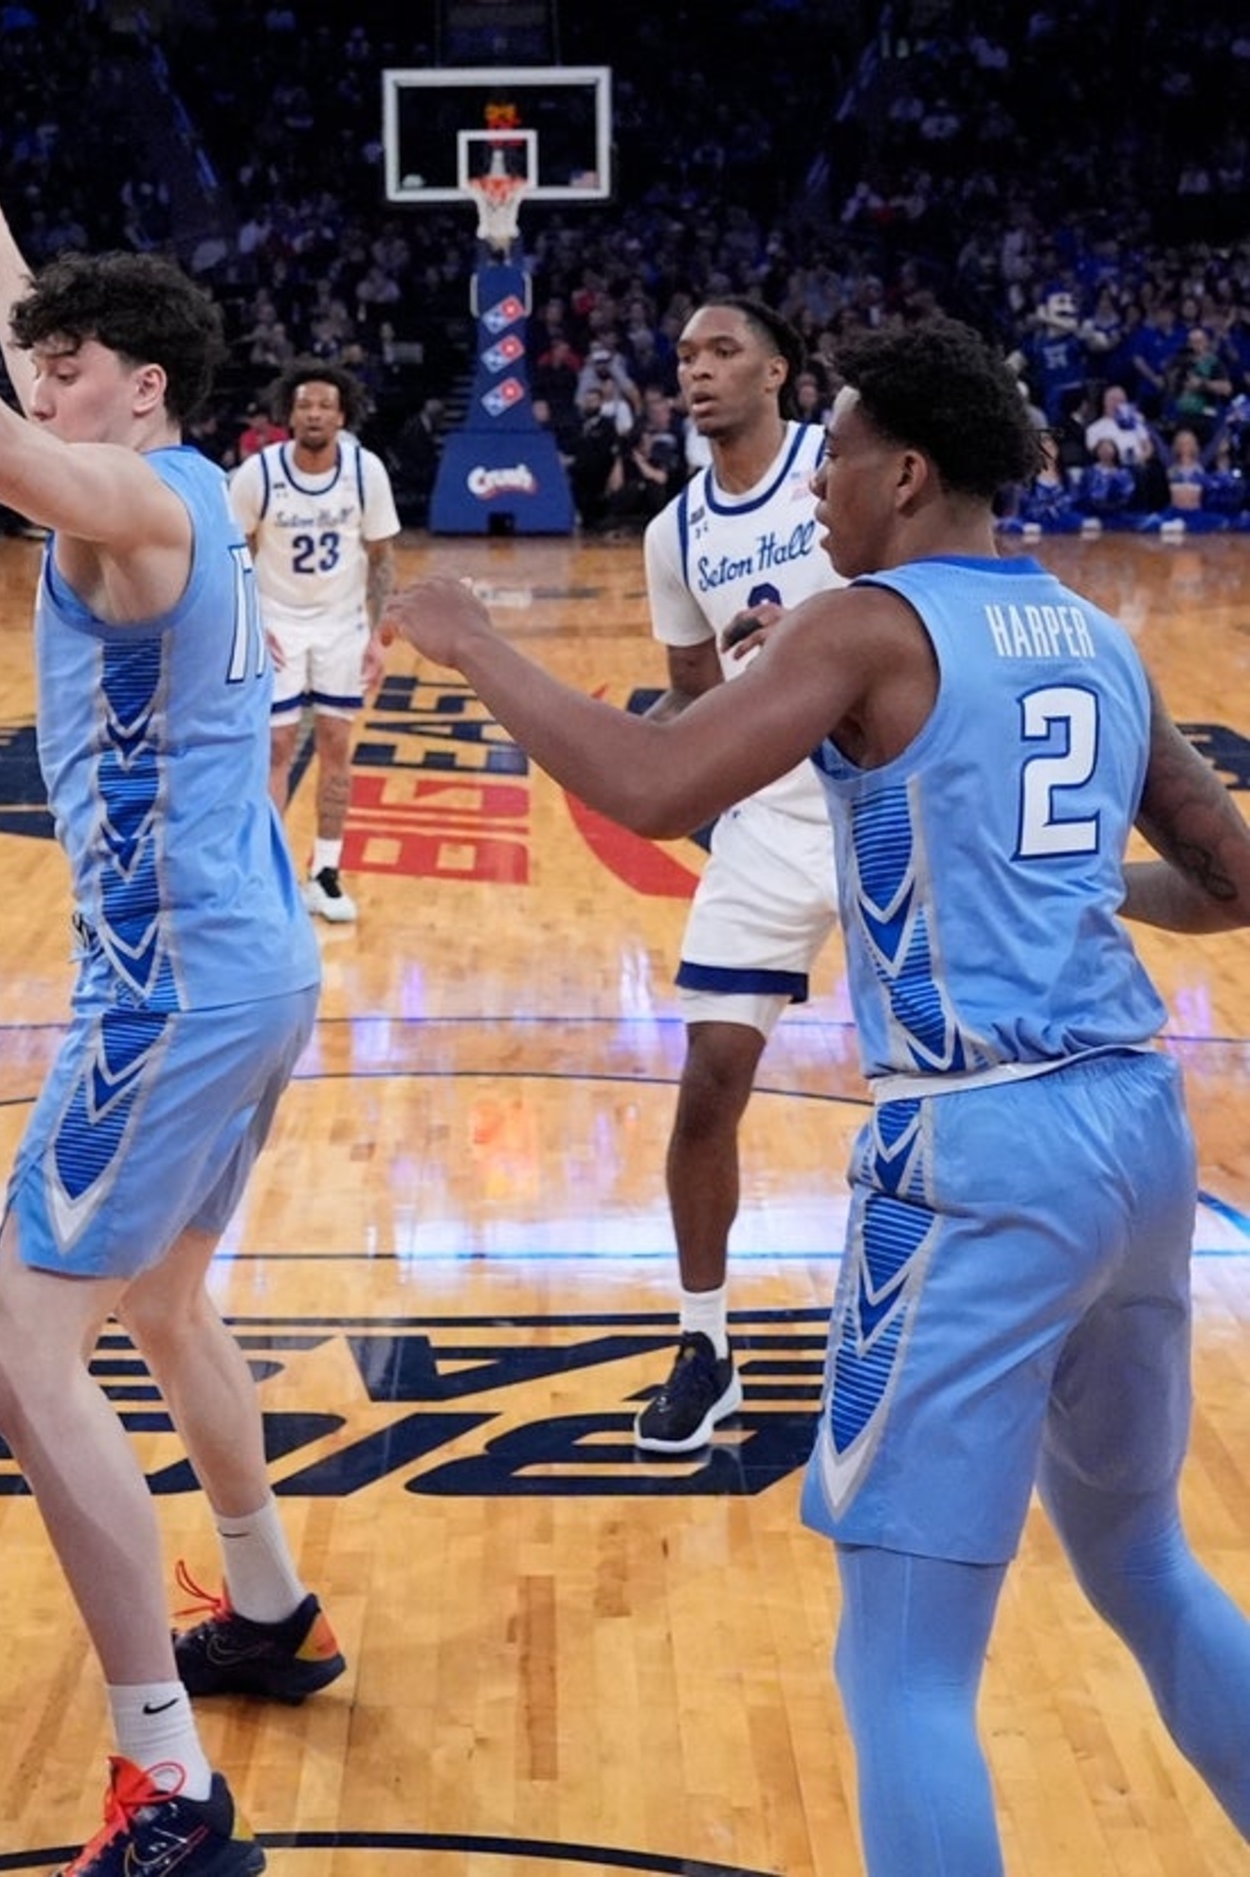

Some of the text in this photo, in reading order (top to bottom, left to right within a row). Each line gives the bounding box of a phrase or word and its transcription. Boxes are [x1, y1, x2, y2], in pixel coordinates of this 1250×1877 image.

[292, 531, 340, 574] 23
[698, 519, 815, 592] Seton Hall
[984, 604, 1095, 657] HARPER
[1010, 682, 1101, 862] 2
